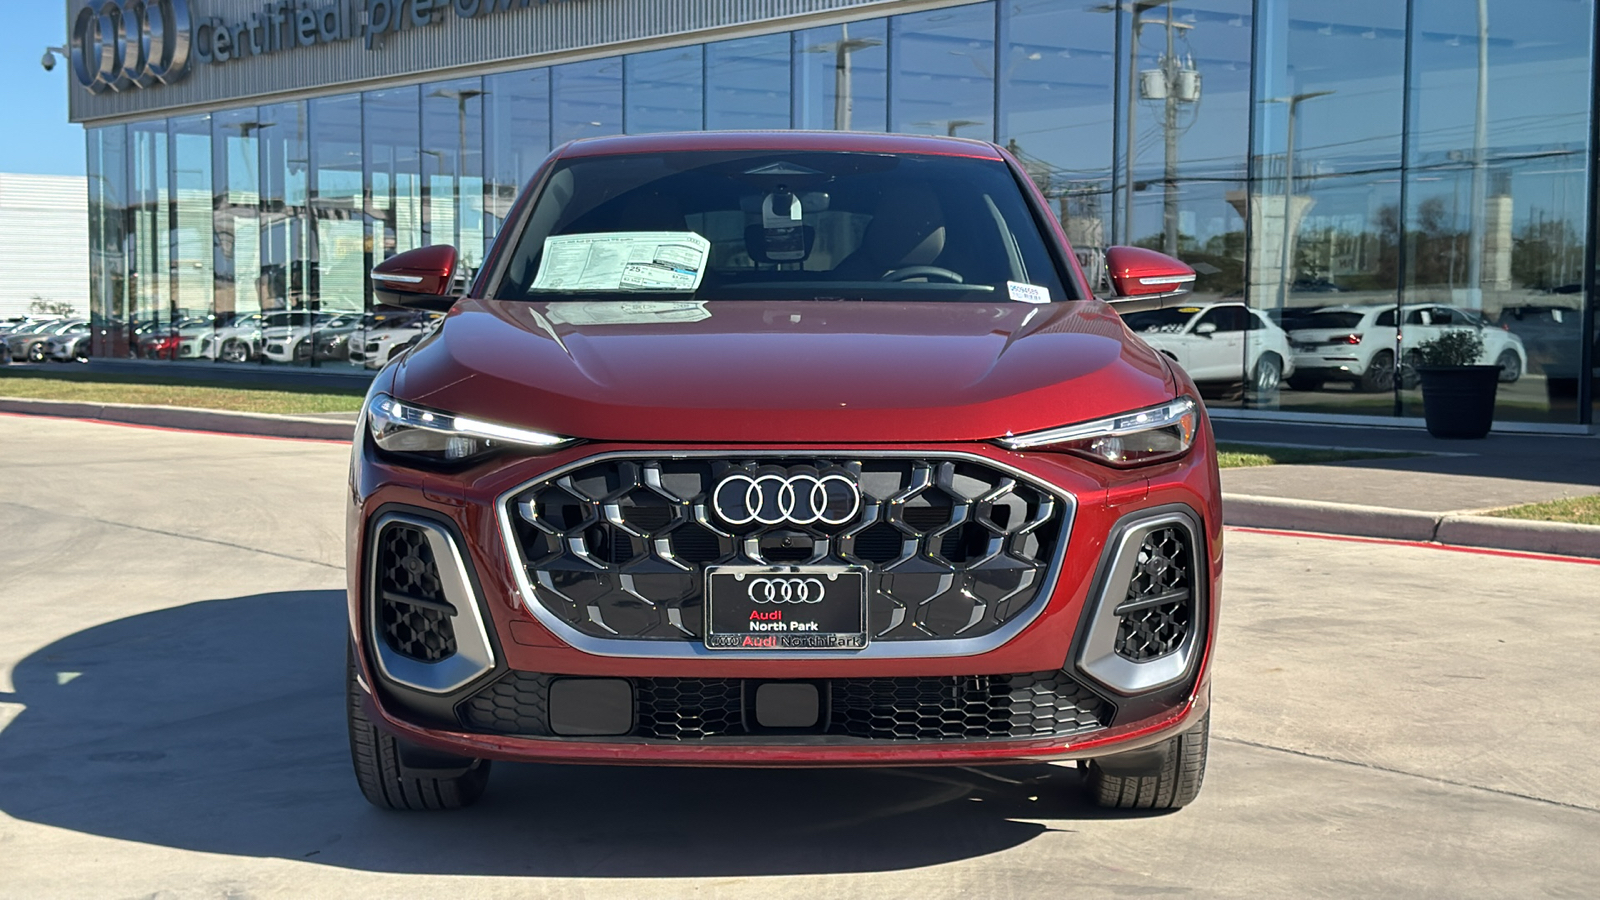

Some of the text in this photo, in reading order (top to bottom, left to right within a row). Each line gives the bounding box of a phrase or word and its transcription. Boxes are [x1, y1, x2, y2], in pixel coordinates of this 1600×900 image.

[750, 610, 782, 620] Audi
[750, 621, 819, 631] North Park
[742, 636, 777, 647] Audi
